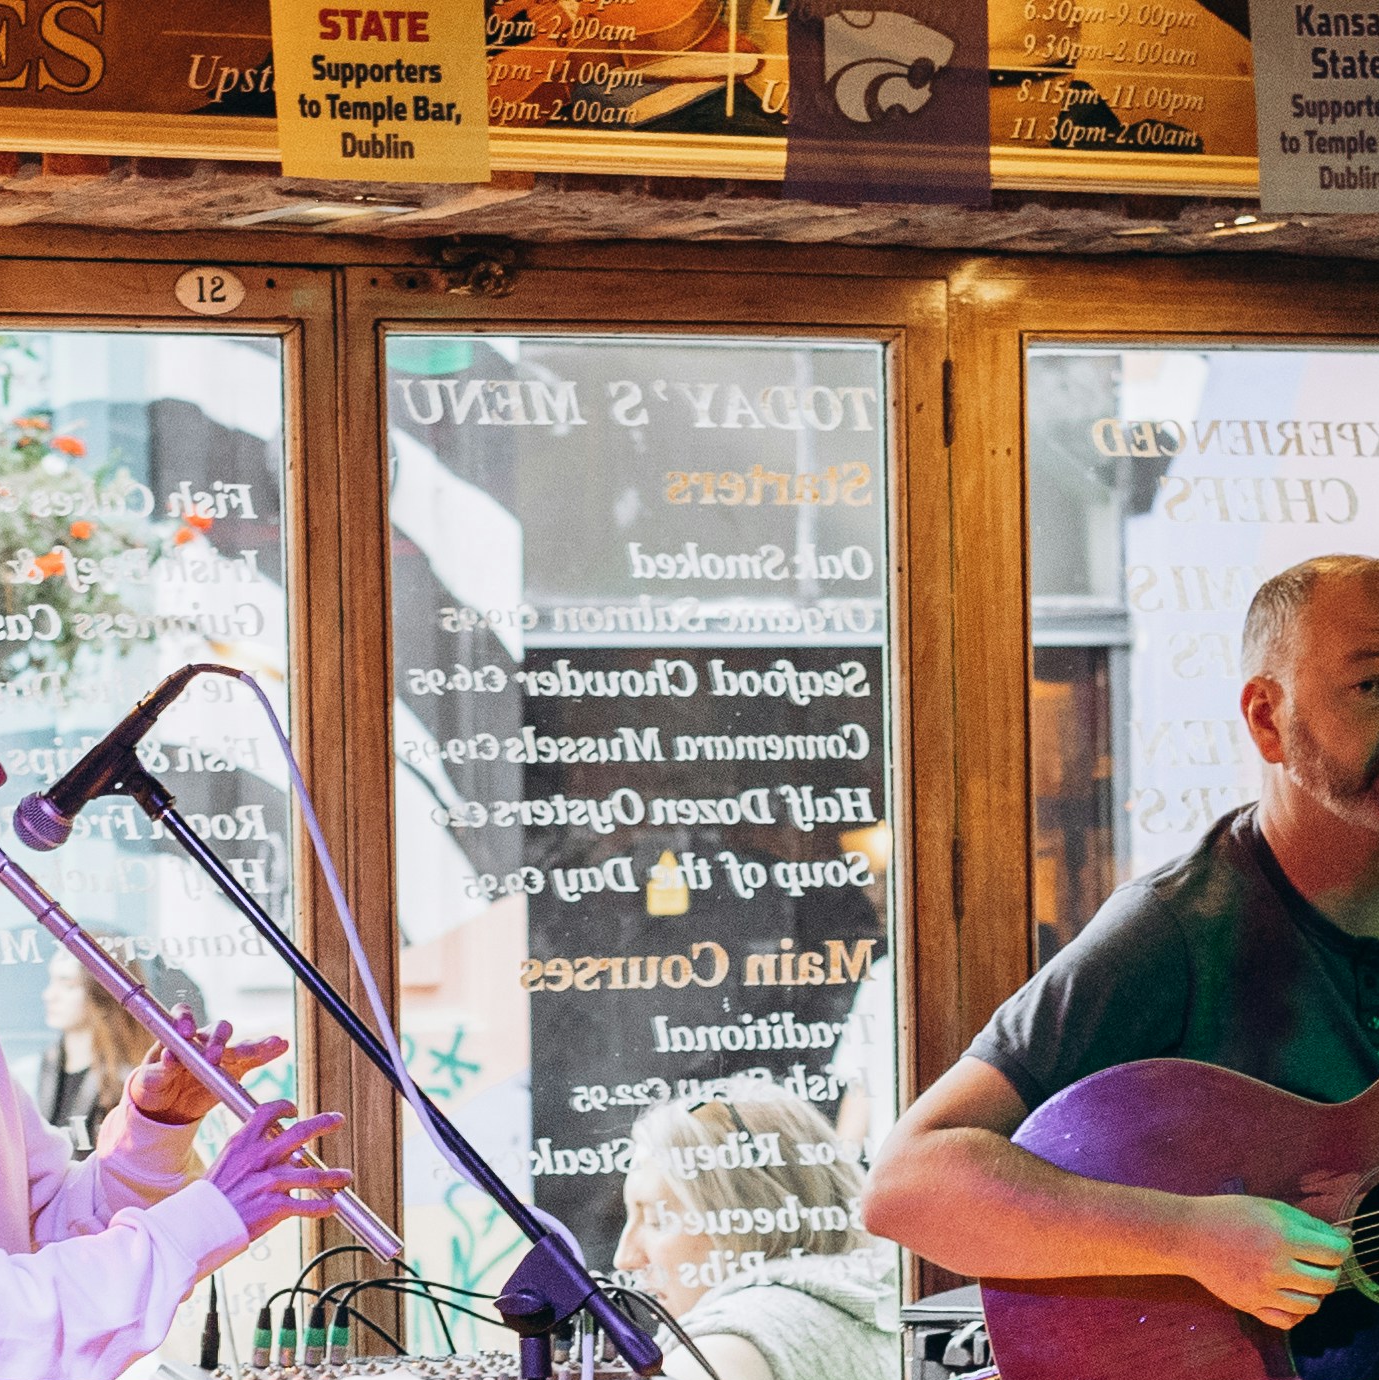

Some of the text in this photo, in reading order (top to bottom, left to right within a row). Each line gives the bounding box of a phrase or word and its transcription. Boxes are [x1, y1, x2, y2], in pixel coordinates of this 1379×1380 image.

[318, 9, 431, 43] STATE
[1019, 33, 1197, 67] 9.30pm-2.00am
[312, 54, 442, 88] Supporters
[299, 94, 462, 127] to Temple Bar,
[1017, 78, 1205, 114] 8.15pm-11.00pm
[341, 131, 415, 161] Dublin
[1010, 117, 1199, 149] 11.30pm-2.00am
[1281, 131, 1301, 156] to
[1305, 130, 1378, 161] Temple
[195, 273, 227, 305] 12
